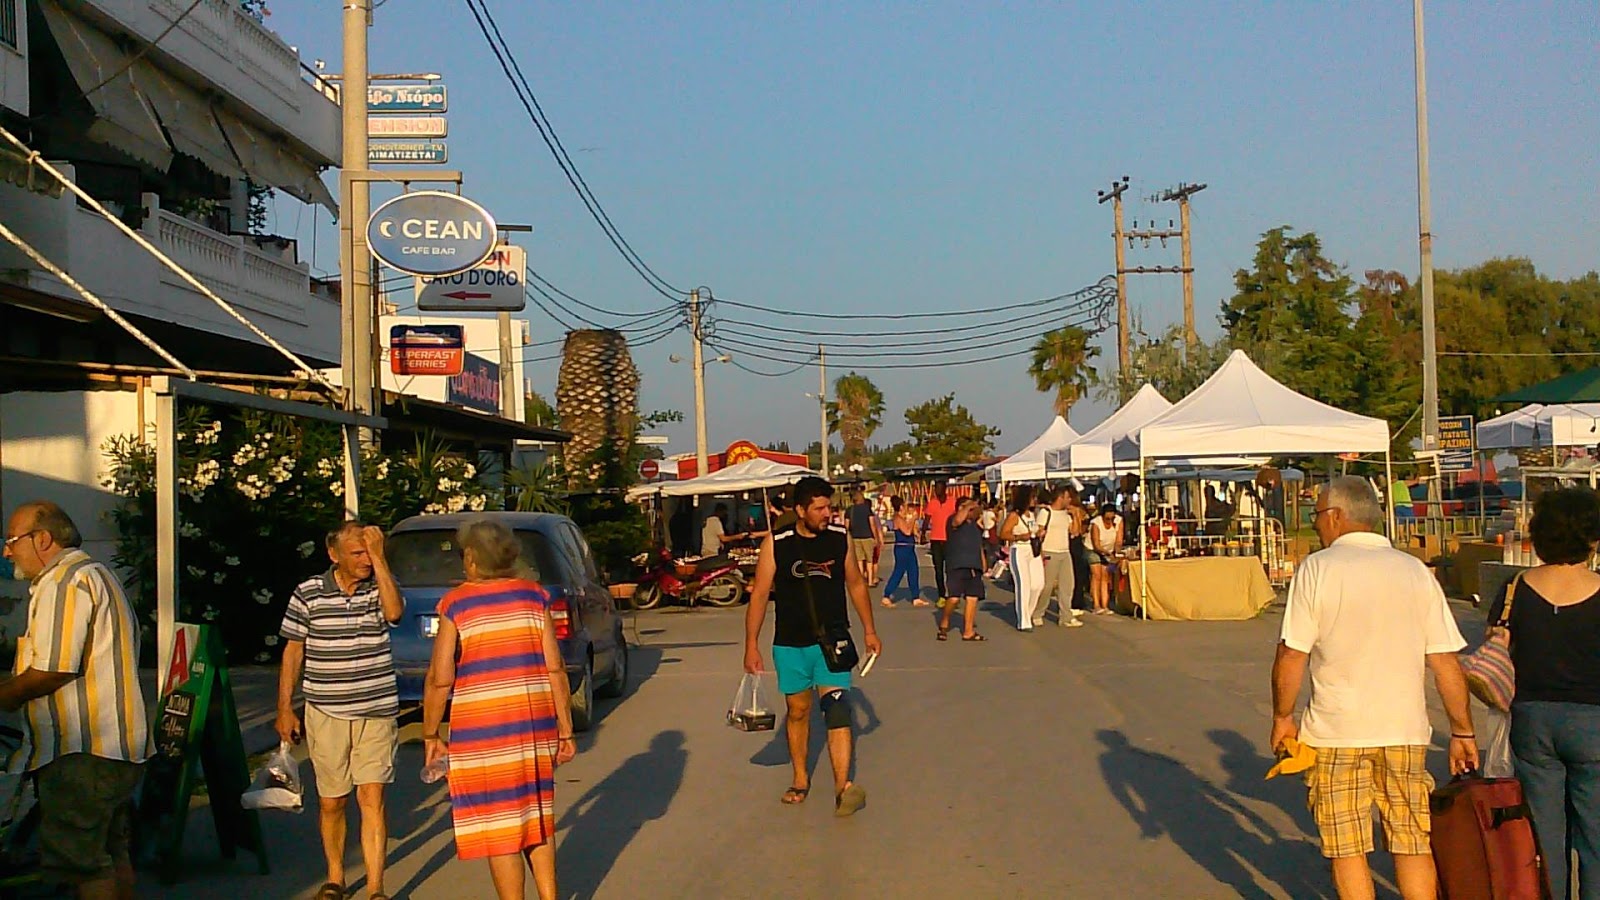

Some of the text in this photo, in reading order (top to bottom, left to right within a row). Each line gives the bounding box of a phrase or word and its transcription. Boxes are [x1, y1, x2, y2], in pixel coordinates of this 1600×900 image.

[368, 119, 442, 133] ENSION
[368, 151, 436, 159] ΛΙΜΑΤΙΖΕΤΑΙ
[402, 246, 456, 255] CAFE BAR
[469, 269, 518, 286] D'ORO
[394, 350, 456, 359] SUPERFAST
[1439, 421, 1462, 429] ΟΣΟΧΗ
[1439, 438, 1471, 448] ΡΑΣΙΝΟ
